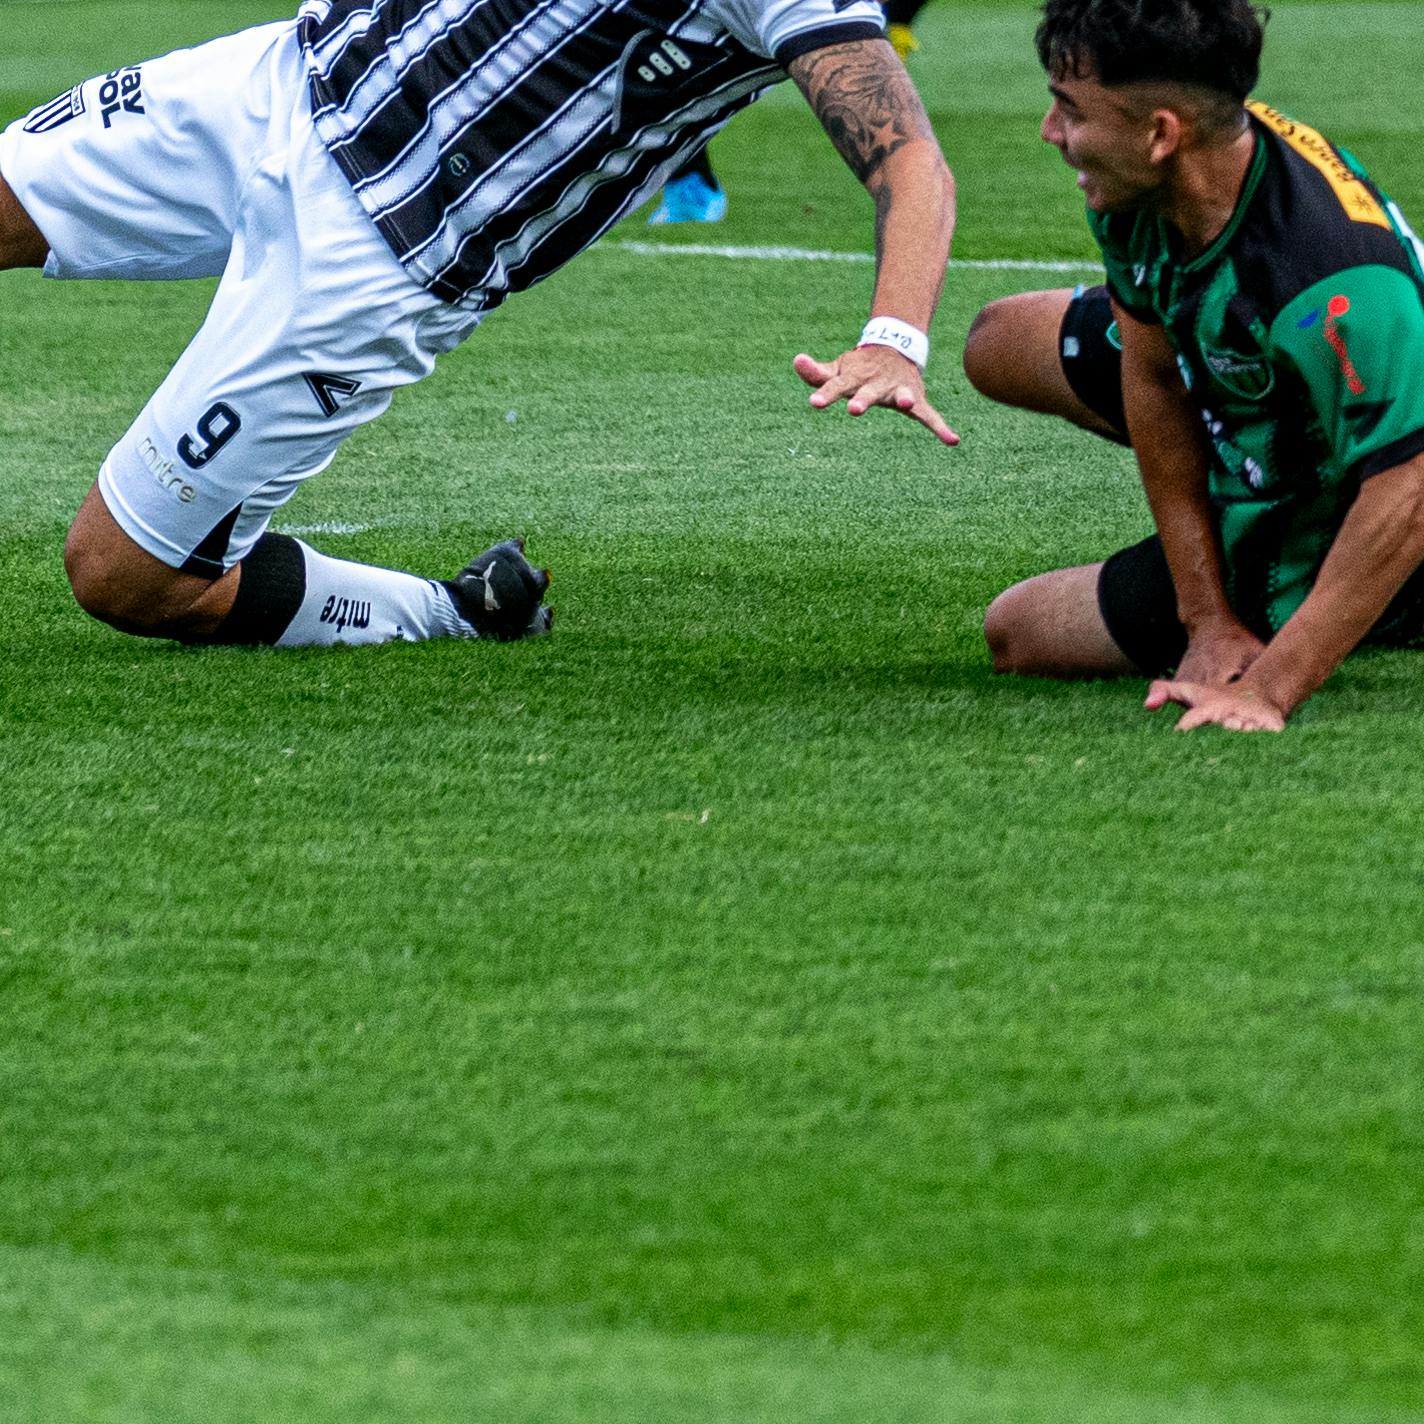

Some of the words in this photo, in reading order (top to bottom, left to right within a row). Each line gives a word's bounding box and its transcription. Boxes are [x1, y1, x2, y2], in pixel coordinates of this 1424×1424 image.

[176, 401, 242, 470] 9
[136, 436, 199, 505] mitre
[319, 593, 372, 635] mitre
